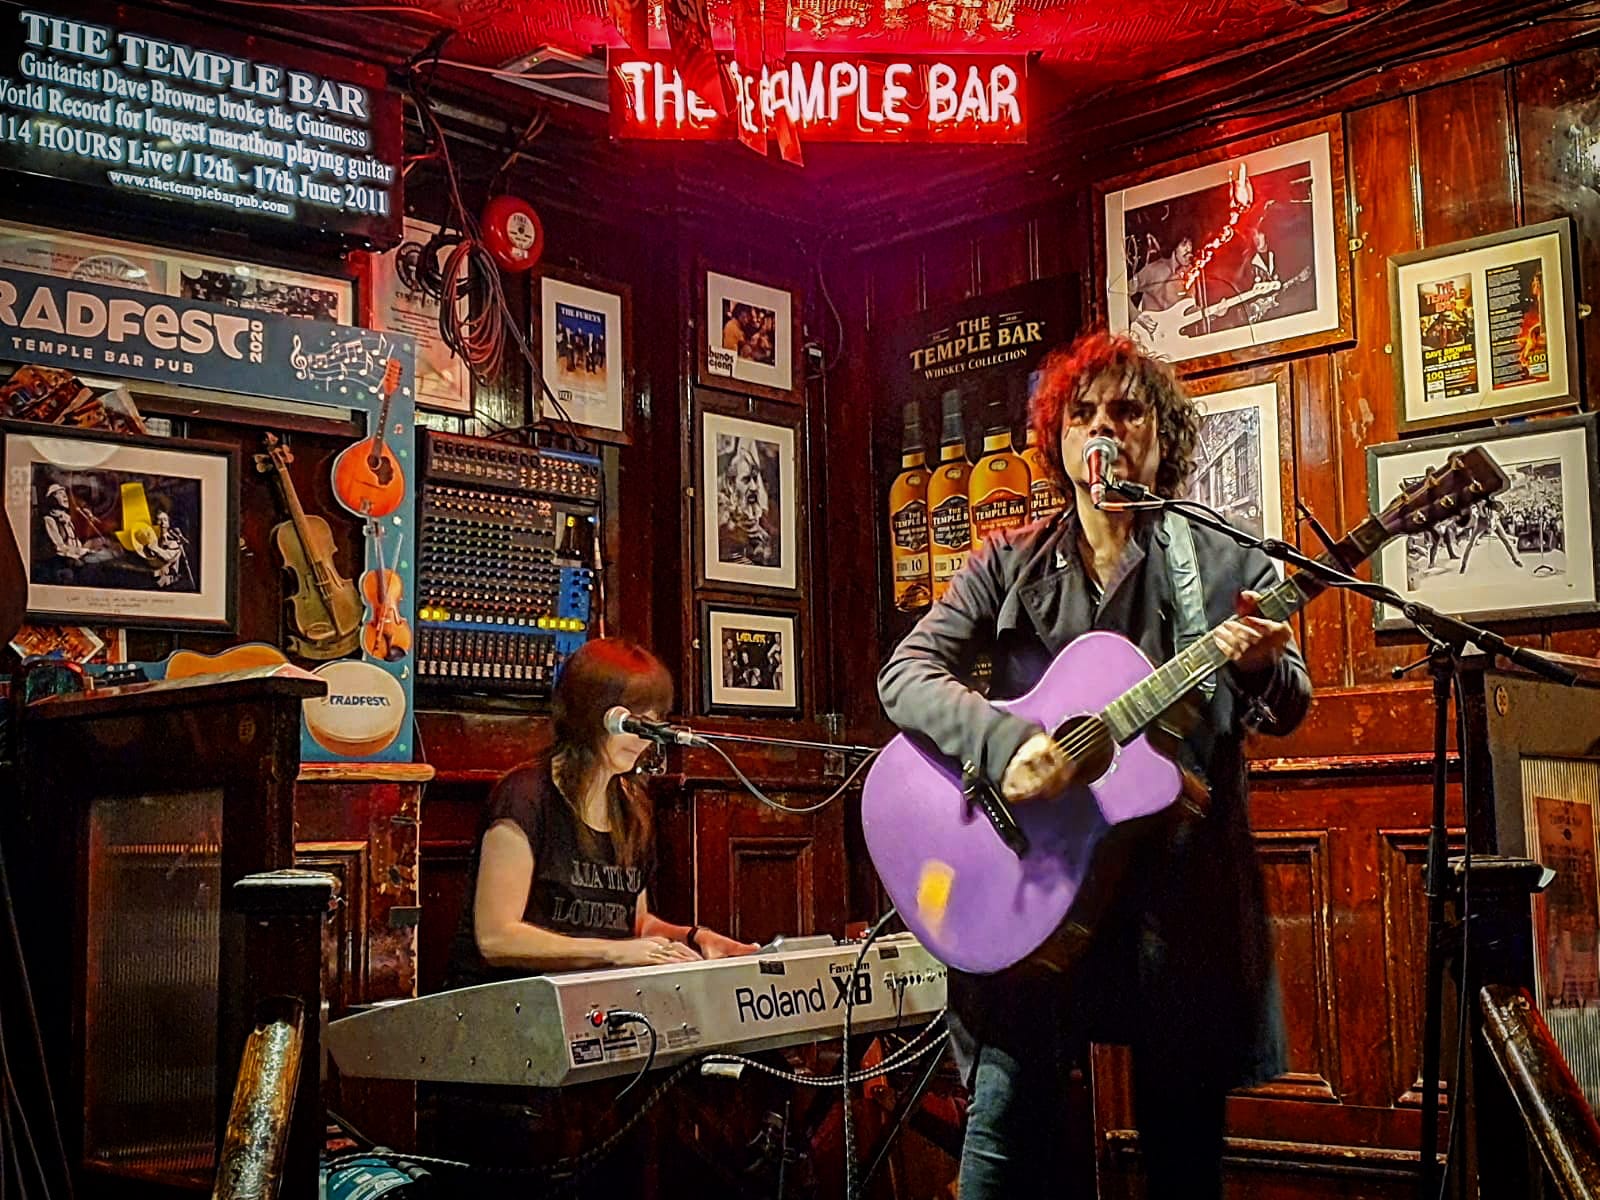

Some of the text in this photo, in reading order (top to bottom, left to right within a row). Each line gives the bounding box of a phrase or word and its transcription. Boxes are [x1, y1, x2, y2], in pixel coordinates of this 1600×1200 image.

[19, 11, 367, 118] THE TEMPLE BAR
[20, 52, 366, 147] Guitarist Dave Browne broke the Guinness
[928, 61, 1021, 123] BAR
[48, 88, 112, 124] Record
[115, 102, 143, 129] for
[145, 108, 207, 144] longest
[209, 127, 284, 159] marathon
[286, 140, 344, 177] playing
[347, 155, 393, 182] guitar
[38, 123, 122, 161] HOURS
[127, 140, 174, 172] Live
[193, 154, 234, 184] 12th
[253, 165, 295, 195] 17th
[298, 174, 341, 204] June
[344, 184, 386, 213] 2011
[108, 171, 290, 214] www.thetemplebarpub.com
[250, 320, 264, 364] 2020
[910, 321, 1042, 370] TEMPLE BAR
[957, 316, 991, 336] THE
[11, 336, 194, 374] TEMPLE BAR PUB
[925, 348, 1028, 380] WHISKEY COLLECTION
[1528, 353, 1546, 363] 100
[976, 507, 1008, 520] TEMPLE
[911, 558, 922, 572] 10
[829, 962, 870, 974] Fantm
[735, 972, 873, 1023] Roland X8
